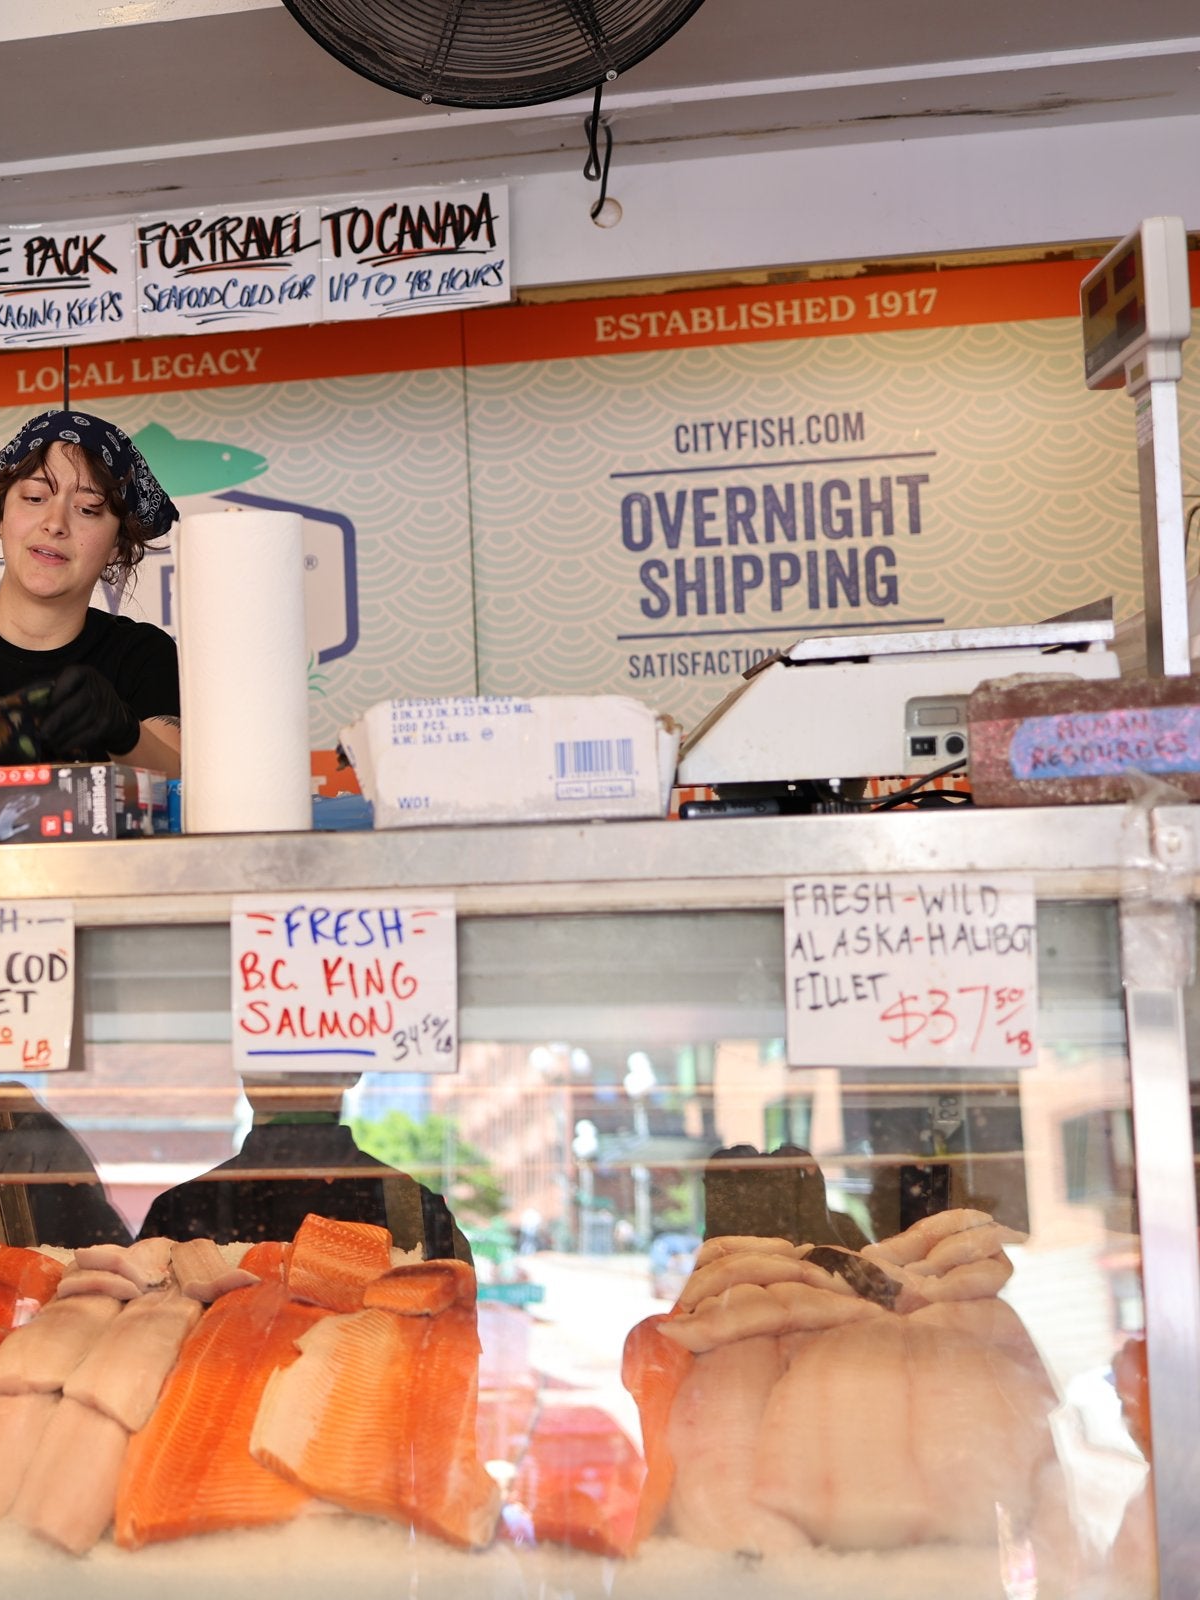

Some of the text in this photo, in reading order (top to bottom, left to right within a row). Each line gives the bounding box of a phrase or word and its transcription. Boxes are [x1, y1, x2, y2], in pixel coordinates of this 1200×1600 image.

[321, 192, 500, 258] TO CANADA
[24, 233, 118, 277] PACK
[329, 259, 505, 303] UP TO 48 HOURS
[66, 291, 124, 329] KEEPS
[595, 287, 938, 343] ESTABLISHED 1917
[17, 347, 262, 394] LOCAL LEGACY
[675, 411, 866, 454] CITYFISH.COM
[620, 473, 930, 553] OVERNIGHT
[639, 544, 899, 620] SHIPPING
[284, 905, 404, 948] FRESH
[5, 952, 69, 984] COD
[322, 956, 418, 1000] KING
[793, 971, 890, 1012] FILLET
[239, 1000, 394, 1038] SALMON
[21, 1038, 52, 1063] LB
